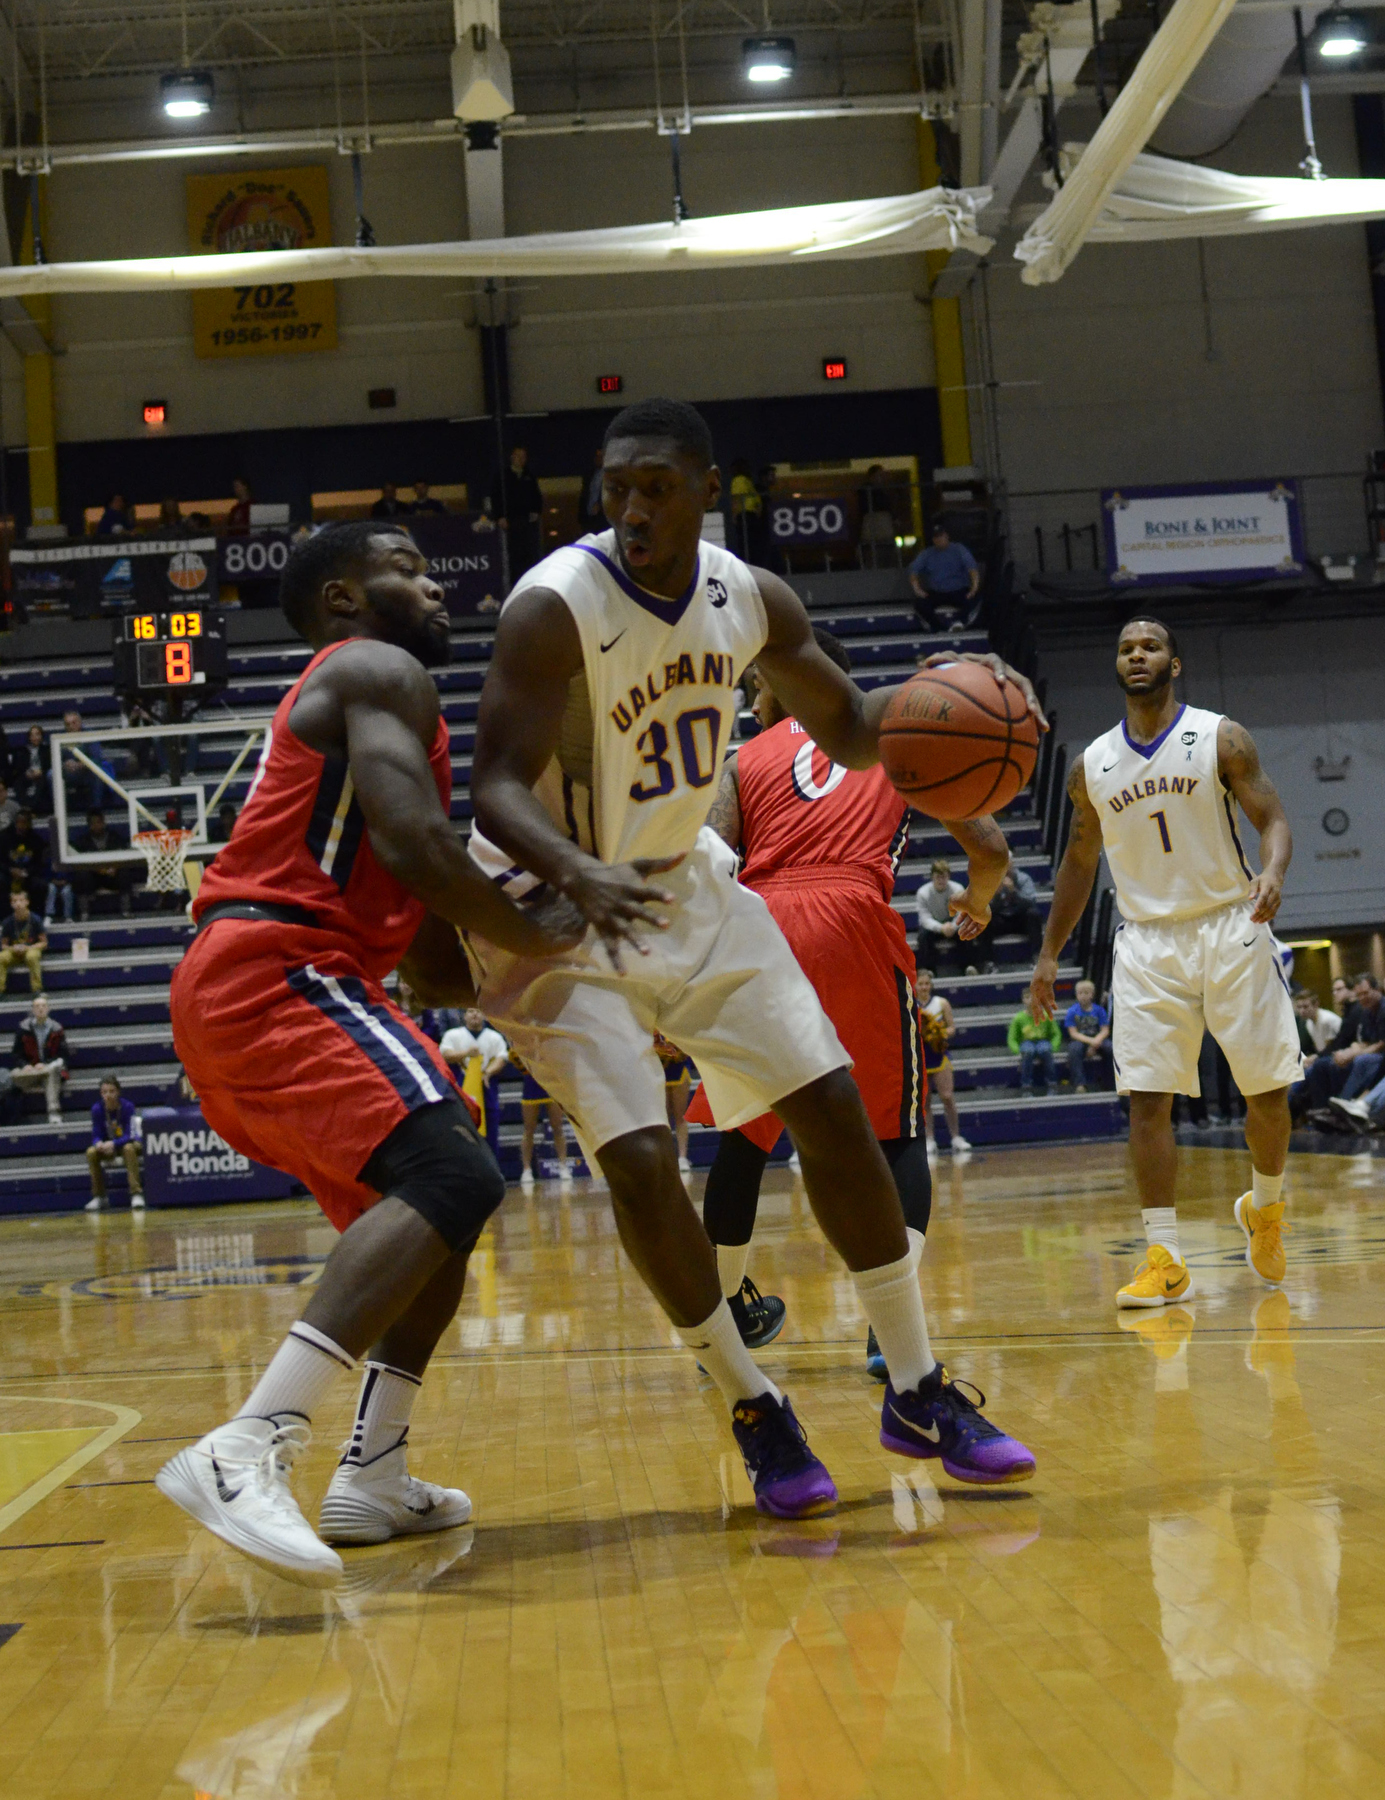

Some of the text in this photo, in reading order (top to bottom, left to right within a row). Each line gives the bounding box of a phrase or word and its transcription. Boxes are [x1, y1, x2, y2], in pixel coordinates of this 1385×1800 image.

[234, 282, 294, 310] 702
[772, 504, 843, 537] 850
[1193, 517, 1207, 533] &
[1211, 515, 1261, 534] JOINT
[225, 541, 288, 574] 800
[426, 554, 490, 574] SIONS
[133, 612, 201, 639] 16 03
[165, 642, 191, 684] 8
[609, 653, 734, 734] UALBAN
[629, 705, 722, 802] 30
[1108, 776, 1199, 813] UALBANY
[1149, 809, 1173, 854] 1
[170, 1149, 250, 1175] Honda
